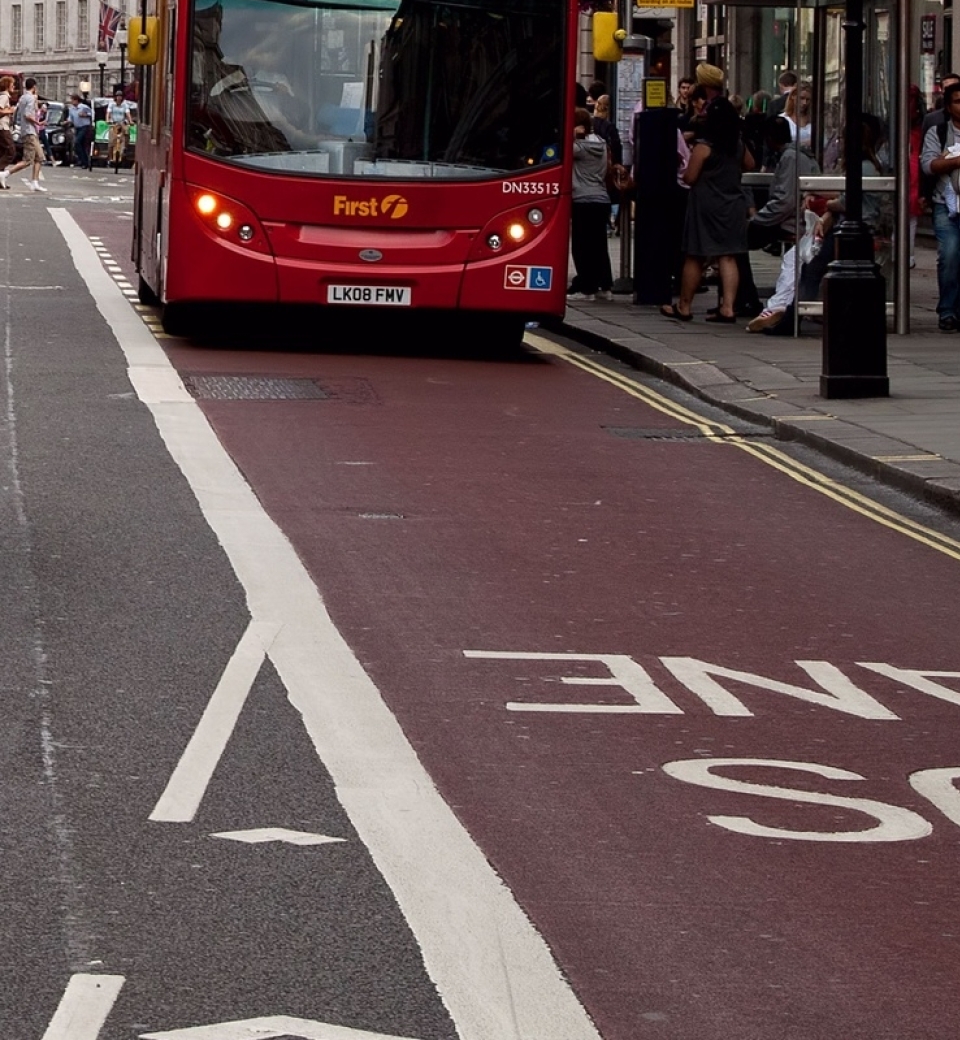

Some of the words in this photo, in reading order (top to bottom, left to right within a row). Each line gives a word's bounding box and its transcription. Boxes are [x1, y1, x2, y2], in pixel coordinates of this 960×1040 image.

[502, 181, 559, 195] DN33513
[333, 195, 378, 217] First
[333, 287, 372, 301] LK08
[376, 288, 404, 302] FMV
